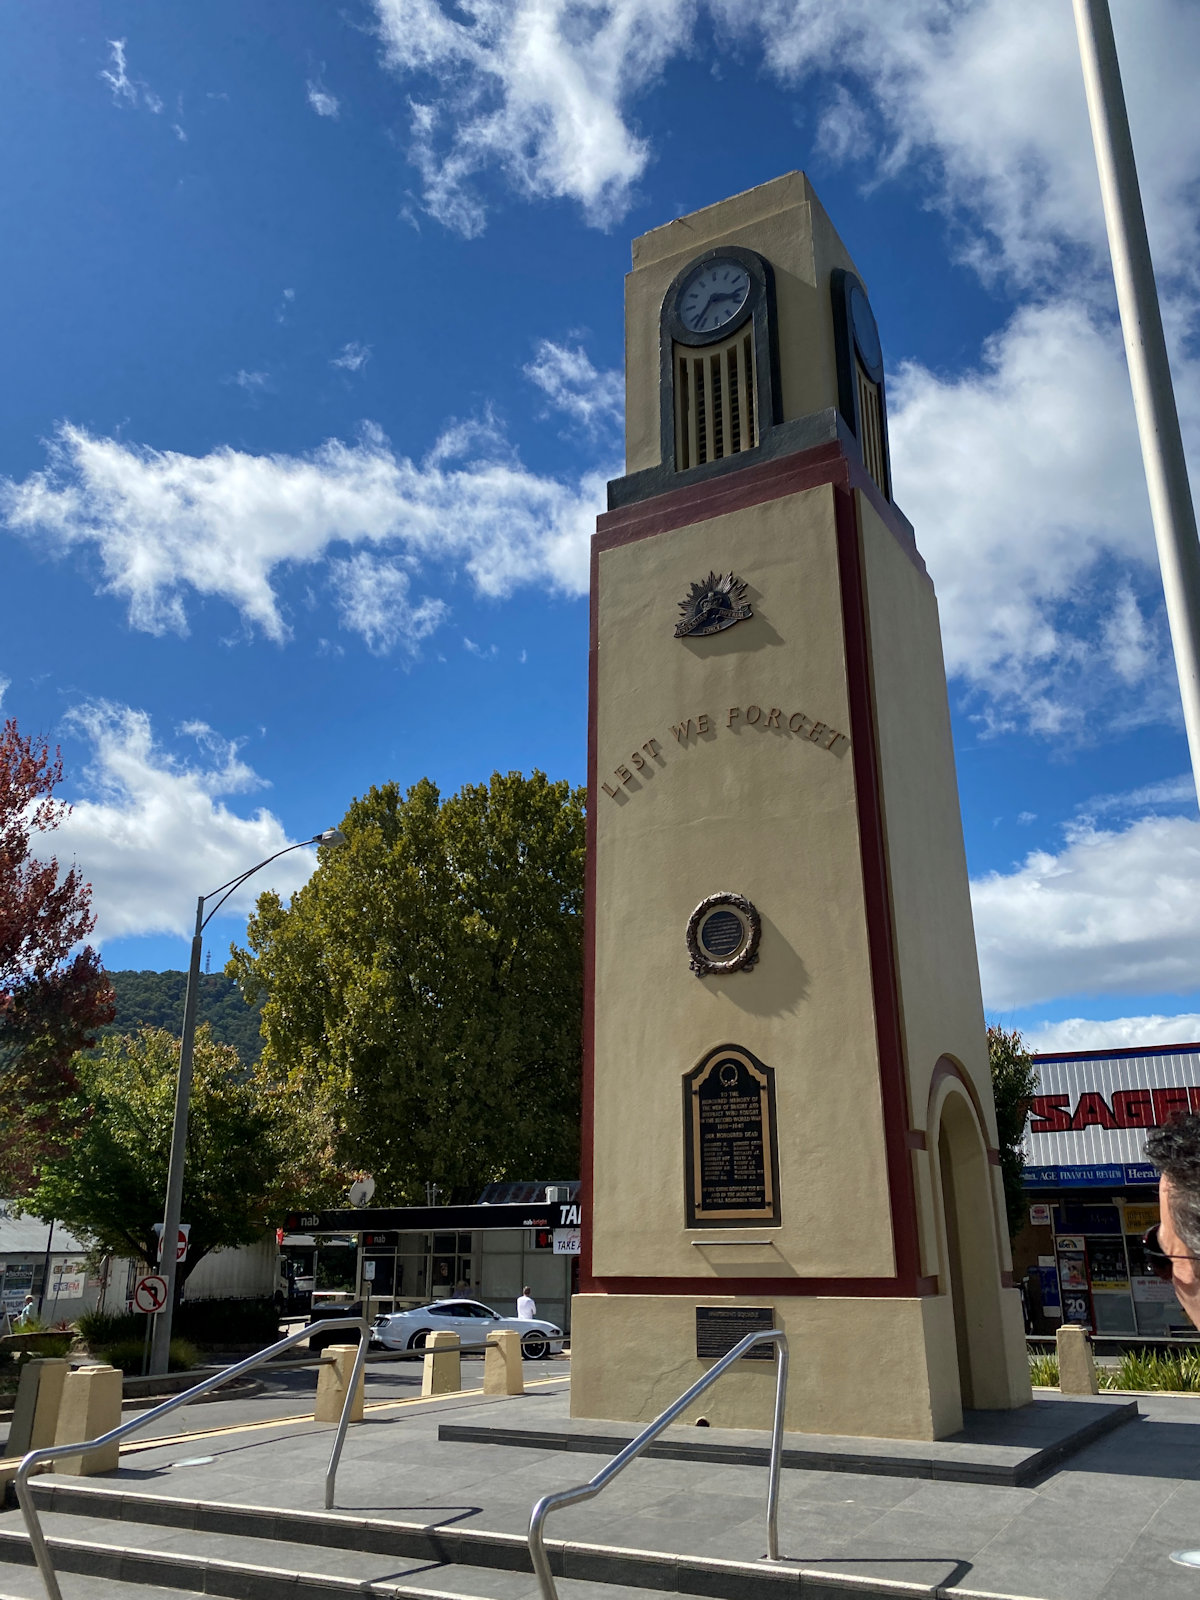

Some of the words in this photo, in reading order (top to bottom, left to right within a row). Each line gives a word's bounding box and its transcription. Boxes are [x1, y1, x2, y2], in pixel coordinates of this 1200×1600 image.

[601, 737, 660, 799] LEST
[668, 713, 710, 743] WE
[725, 704, 846, 751] FORGET
[1040, 1171, 1058, 1181] AGE
[300, 1214, 320, 1227] nab
[373, 1235, 386, 1243] nab
[557, 1240, 576, 1251] TAKE
[1065, 1299, 1086, 1313] 20
